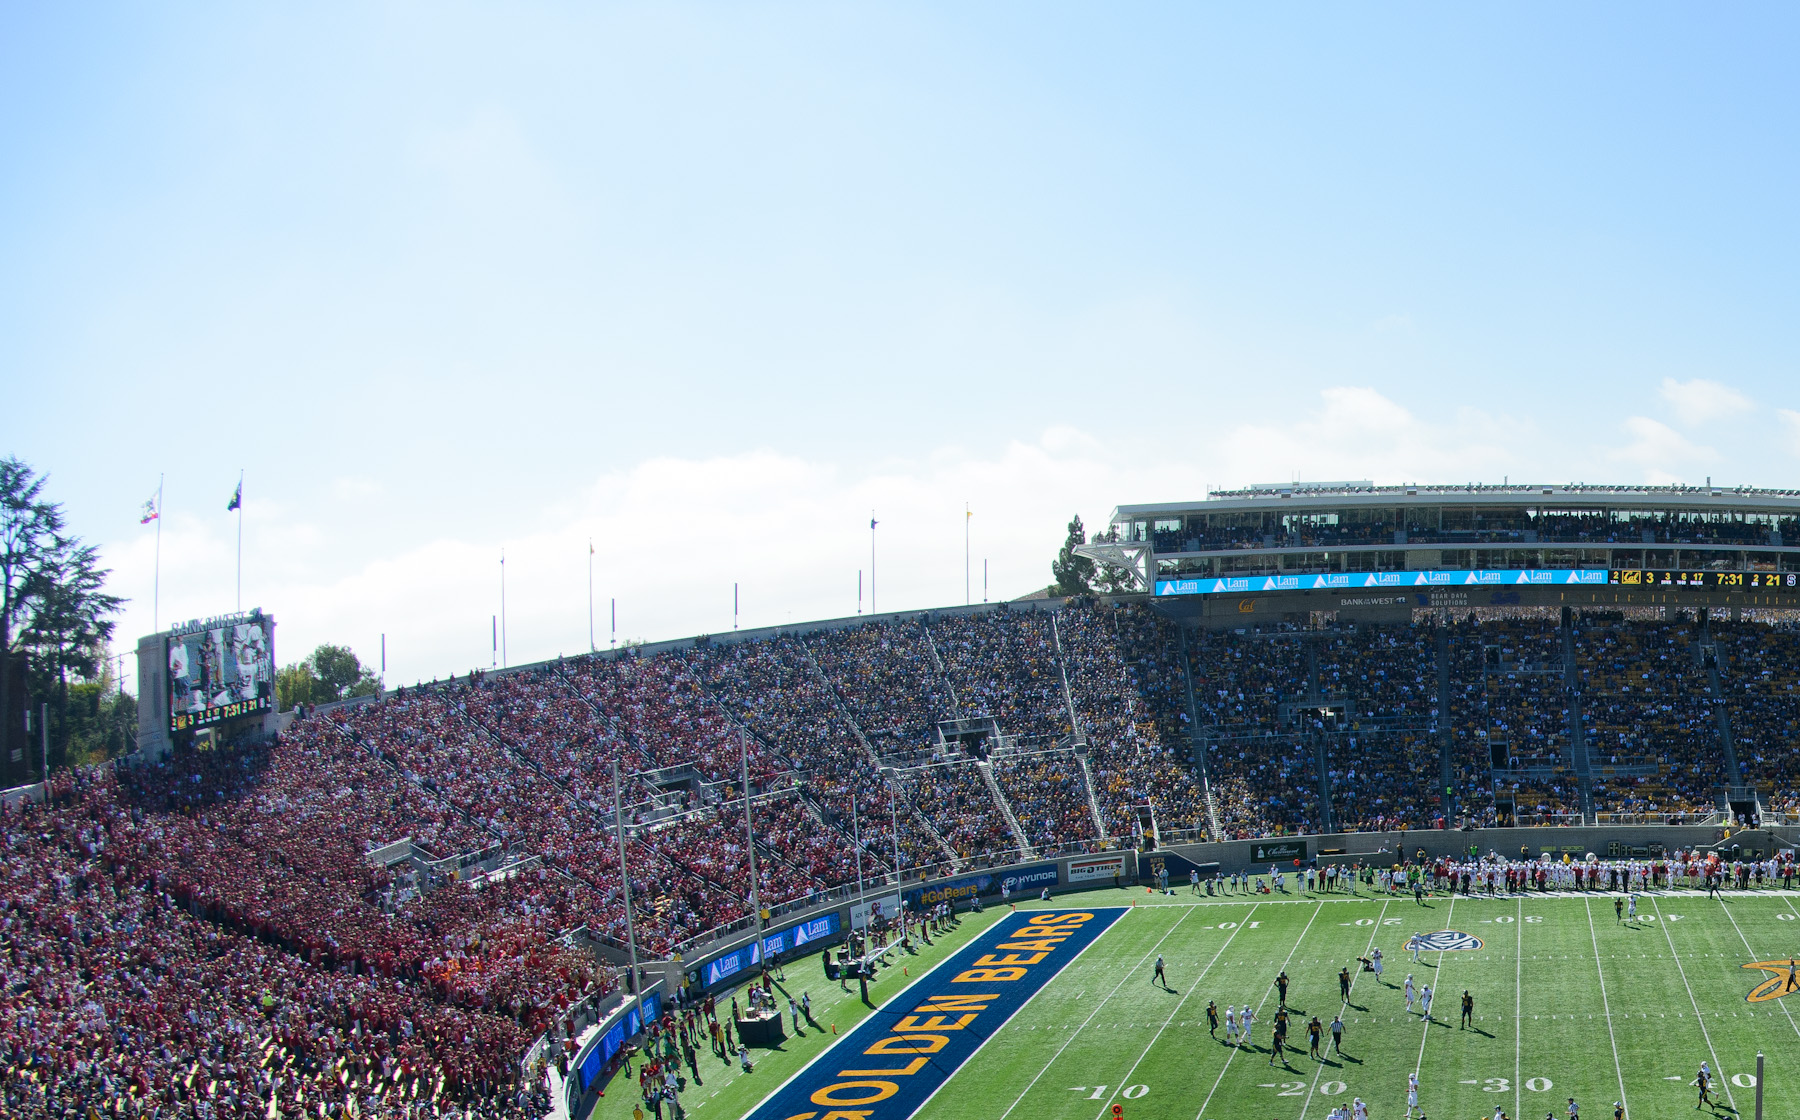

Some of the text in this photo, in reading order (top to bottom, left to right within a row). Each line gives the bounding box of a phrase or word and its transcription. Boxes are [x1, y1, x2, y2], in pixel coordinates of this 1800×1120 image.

[1328, 574, 1349, 585] Lam
[1379, 572, 1400, 582] Lam
[1429, 571, 1450, 581] Lam
[1479, 571, 1501, 581] Lam
[1531, 570, 1552, 580] Lam
[1581, 570, 1602, 580] Lam
[1646, 573, 1654, 584] 3
[1693, 573, 1703, 581] 17
[1717, 573, 1743, 585] 7:31
[1766, 574, 1780, 586] 21
[1176, 581, 1197, 591] Lam
[1228, 578, 1249, 589] Lam
[1278, 576, 1299, 587] Lam
[1371, 597, 1394, 605] WEST
[171, 617, 206, 637] BANK
[213, 611, 246, 630] WEST
[223, 703, 241, 718] 7:31
[248, 700, 257, 711] 21
[1019, 871, 1057, 884] HYUNDAI
[921, 885, 978, 904] #GoBears
[807, 919, 829, 937] Lam
[951, 912, 1095, 983] BEARS
[720, 954, 739, 972] Lam
[1277, 1080, 1348, 1097] 20
[1482, 1076, 1553, 1093] 30
